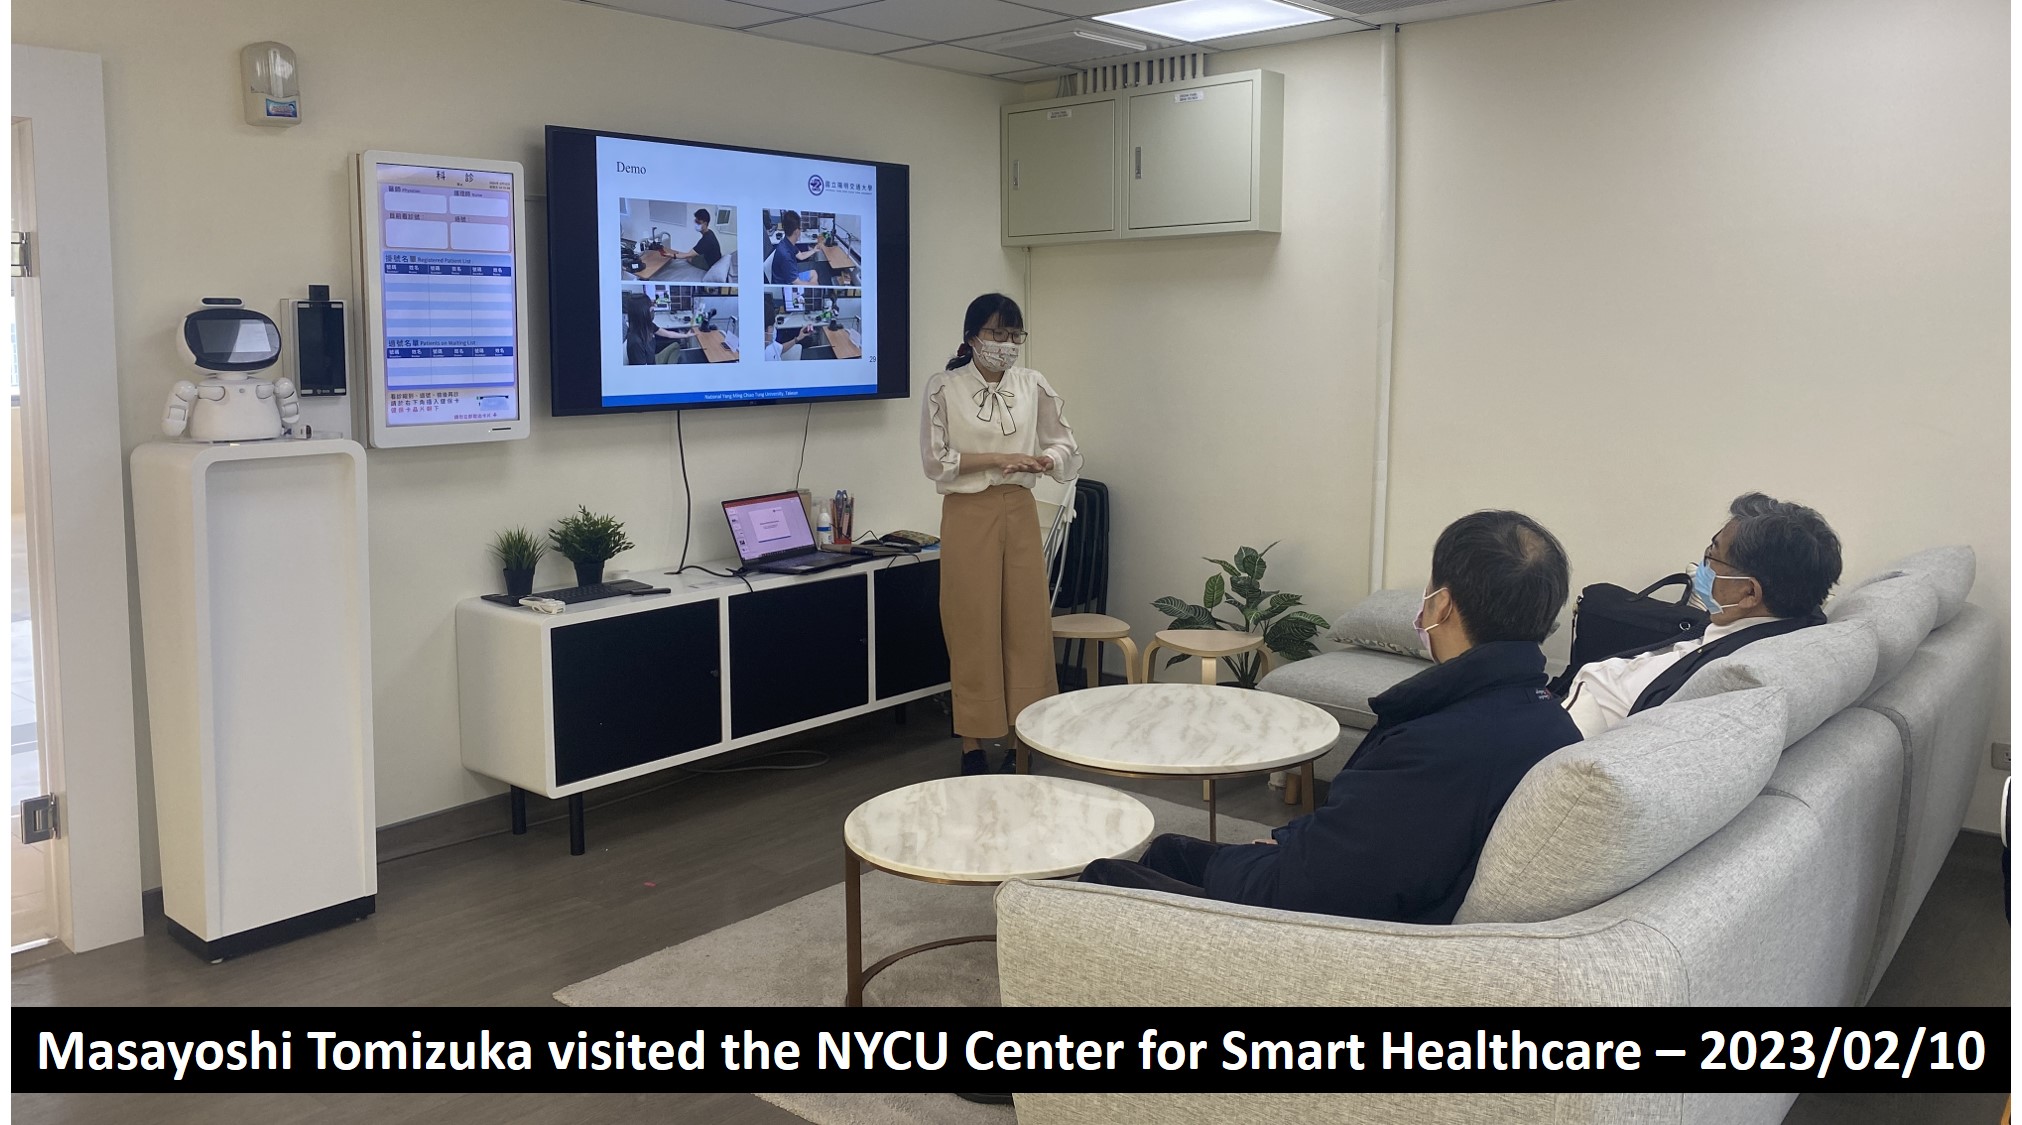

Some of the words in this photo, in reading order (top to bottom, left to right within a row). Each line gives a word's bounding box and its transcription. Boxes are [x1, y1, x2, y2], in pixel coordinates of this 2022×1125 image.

[616, 161, 647, 175] Demo
[825, 180, 873, 192] 國立陽明交通大學
